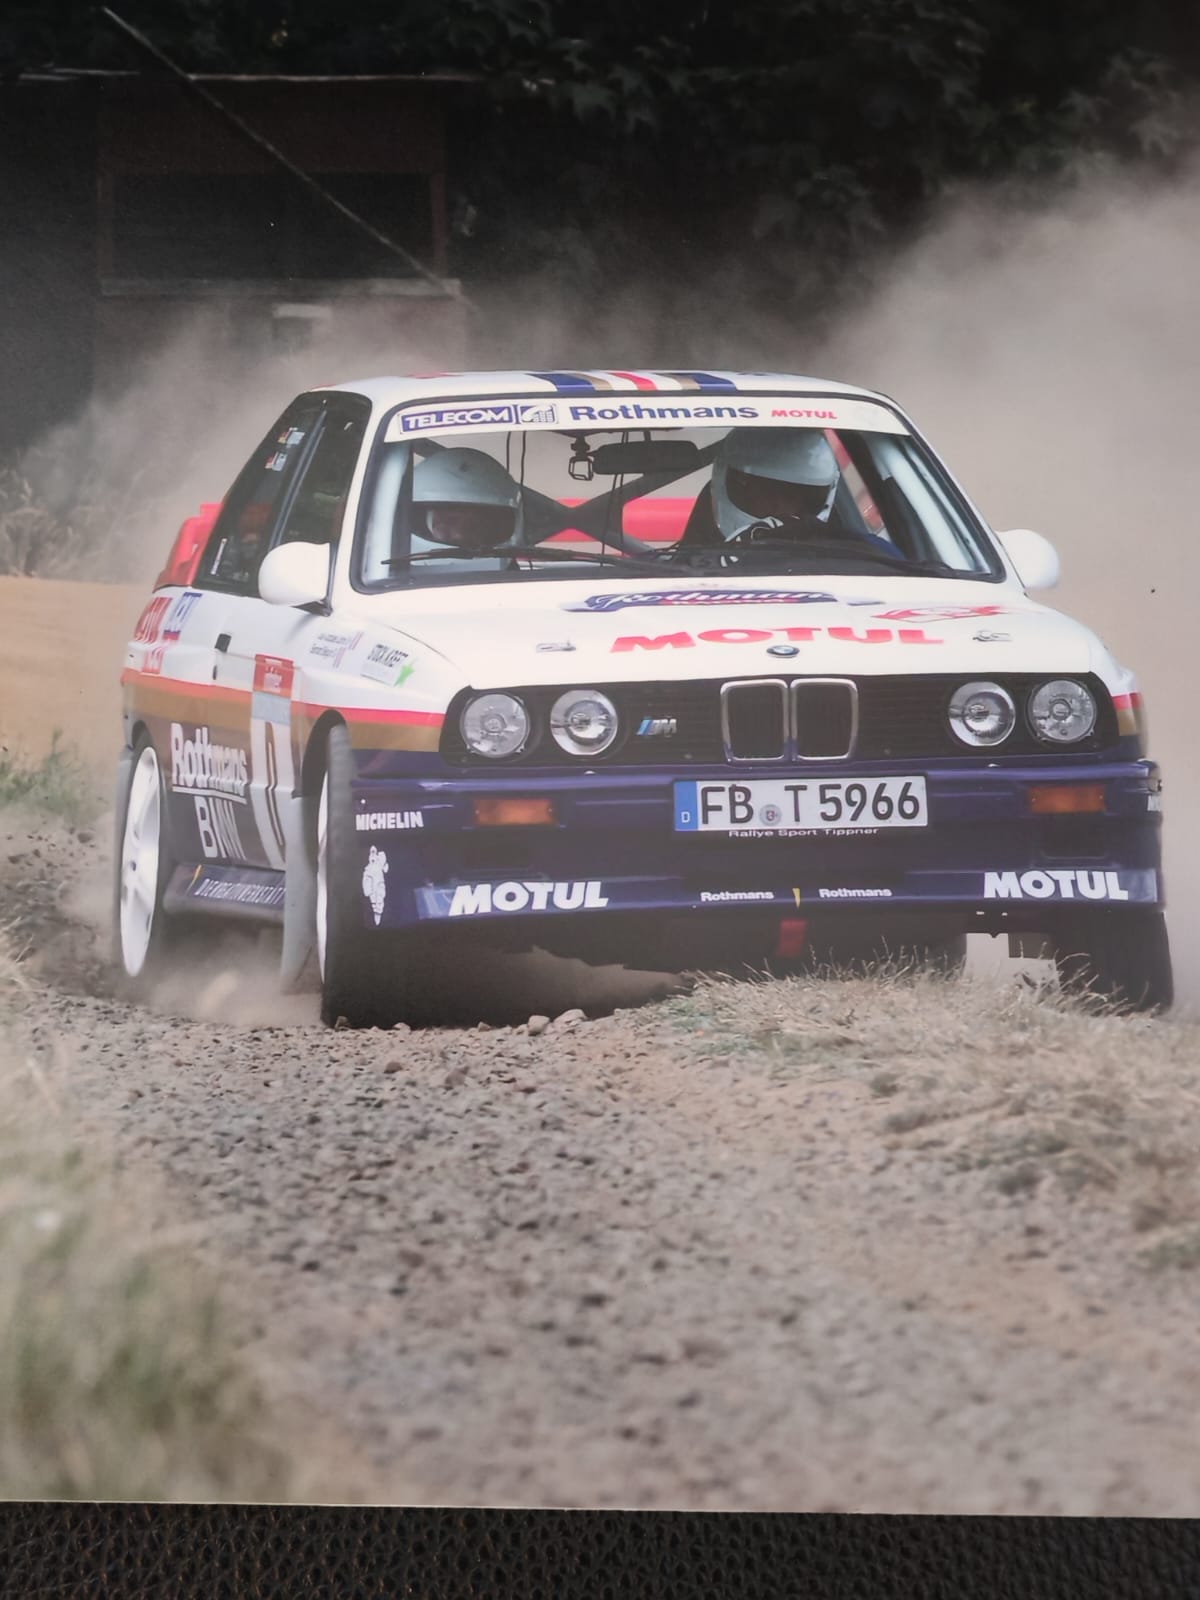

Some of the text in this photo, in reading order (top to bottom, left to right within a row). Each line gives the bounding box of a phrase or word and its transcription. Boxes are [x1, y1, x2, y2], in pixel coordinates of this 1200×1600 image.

[404, 408, 510, 429] TELECOM
[570, 403, 759, 422] Rothmans
[771, 408, 838, 420] MOTUL
[610, 627, 945, 653] MOTUL
[170, 722, 249, 797] Rothmans
[700, 784, 754, 825] FB
[356, 811, 424, 831] MICHELIN
[681, 811, 690, 824] D
[728, 826, 879, 839] Rallye Sport Tippner
[700, 887, 892, 902] Rothmans Rothmans
[983, 870, 1129, 900] MOTUL
[448, 881, 609, 916] MOTUL
